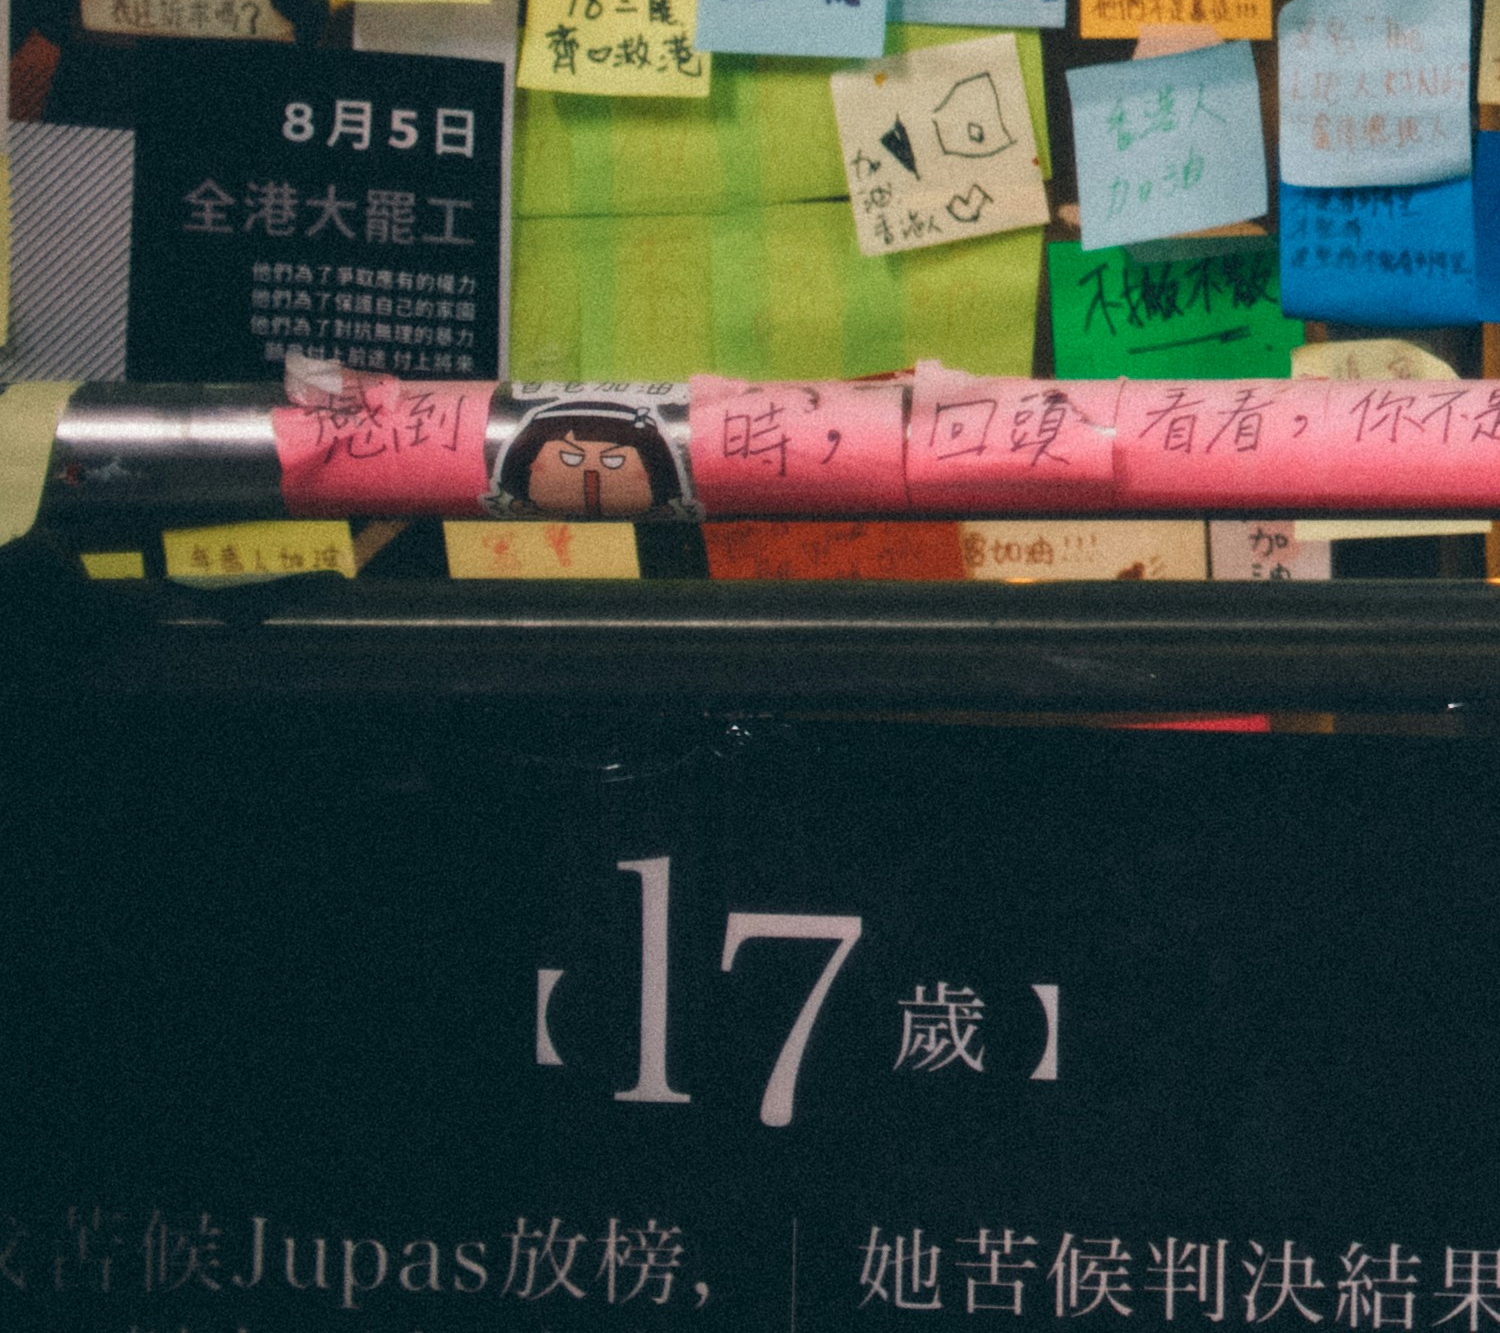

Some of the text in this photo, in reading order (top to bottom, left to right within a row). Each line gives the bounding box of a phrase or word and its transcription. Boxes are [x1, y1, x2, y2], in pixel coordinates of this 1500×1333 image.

[281, 99, 476, 157] 8月5日
[181, 177, 477, 248] 全港大罷工
